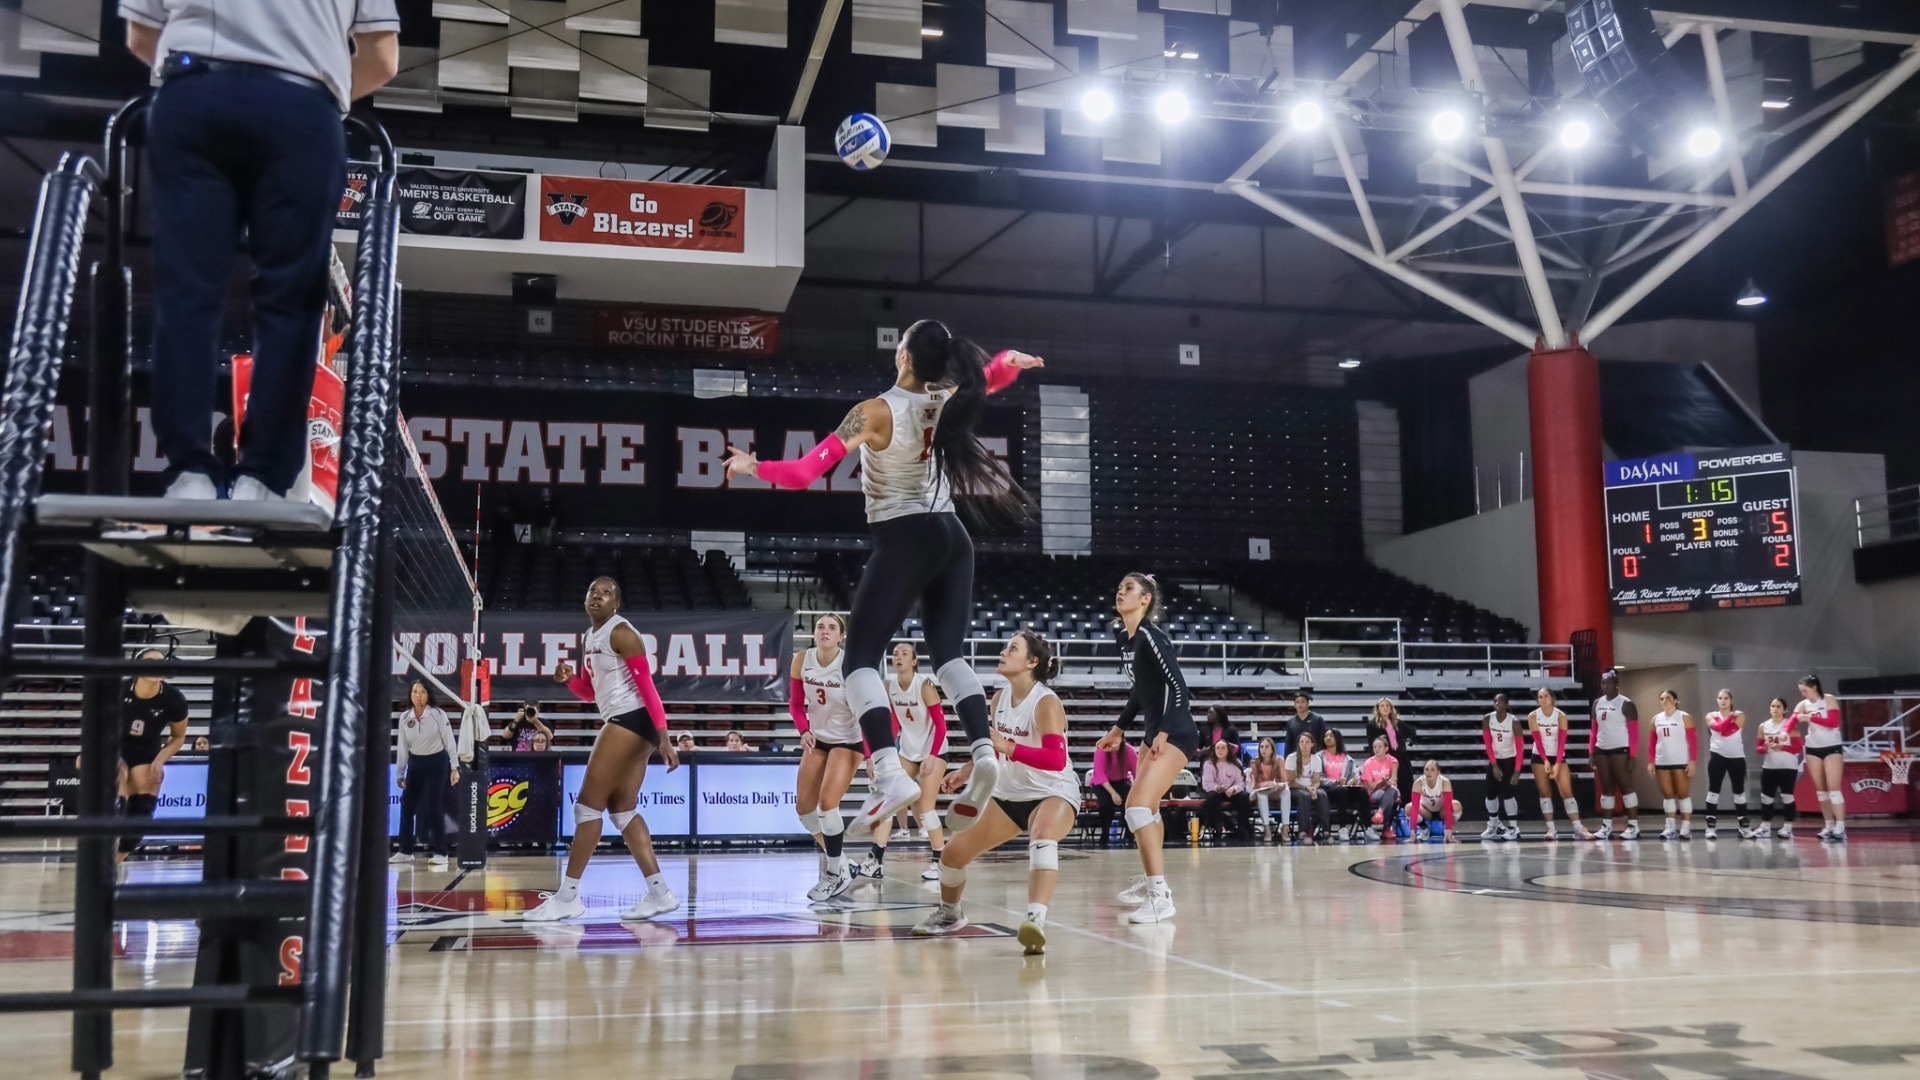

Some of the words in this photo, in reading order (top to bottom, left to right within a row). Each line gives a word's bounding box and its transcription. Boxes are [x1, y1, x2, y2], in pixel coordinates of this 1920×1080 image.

[399, 188, 439, 200] MEN'S
[442, 191, 515, 205] BASKETBALL
[630, 193, 658, 214] Go
[336, 211, 360, 219] AZERS
[553, 203, 580, 213] STATE
[593, 213, 694, 239] Blazers!
[623, 317, 656, 331] VSU
[661, 318, 750, 334] STUDENTS
[609, 331, 679, 346] ROCKIN'
[682, 334, 715, 347] THE
[720, 336, 764, 350] PLEX!
[312, 423, 333, 439] STAT
[405, 416, 645, 485] STATE
[1620, 461, 1678, 481] DASANI
[1698, 452, 1785, 470] POWERADE
[1686, 479, 1732, 503] 1:15
[1742, 498, 1789, 512] GUEST
[1612, 511, 1650, 523] HOME
[1681, 510, 1714, 520] PERIOD
[1717, 516, 1738, 526] POSS
[1771, 511, 1788, 534] 5
[1659, 521, 1679, 530] POSS
[1692, 518, 1707, 541] 3
[1713, 528, 1738, 537] BONUS
[1645, 524, 1652, 544] 1
[1660, 533, 1685, 542] BONUS
[1762, 535, 1792, 544] FOULS
[1613, 547, 1640, 556] FOULS
[1675, 541, 1711, 551] PLAYER
[1715, 539, 1738, 548] FOUL
[1774, 544, 1790, 567] 2
[1623, 556, 1638, 578] 0
[1613, 589, 1638, 601] Little
[1640, 589, 1663, 599] River
[1666, 586, 1701, 599] Flooring
[1705, 582, 1732, 594] Little
[1734, 582, 1759, 592] River
[1761, 579, 1799, 592] Flooring
[392, 631, 777, 676] VOLLEALL
[815, 688, 826, 705] 3
[905, 708, 914, 721] 4
[130, 719, 145, 736] 9
[1545, 728, 1552, 737] 5
[1663, 727, 1670, 737] 11
[56, 777, 80, 786] molt
[1859, 780, 1884, 789] STATE
[158, 794, 192, 807] dosta
[486, 781, 529, 818] SC
[636, 792, 650, 808] ily
[651, 792, 685, 805] Times
[702, 792, 749, 805] Valdosta
[752, 791, 780, 808] Daily
[1198, 1022, 1774, 1069] LADY
